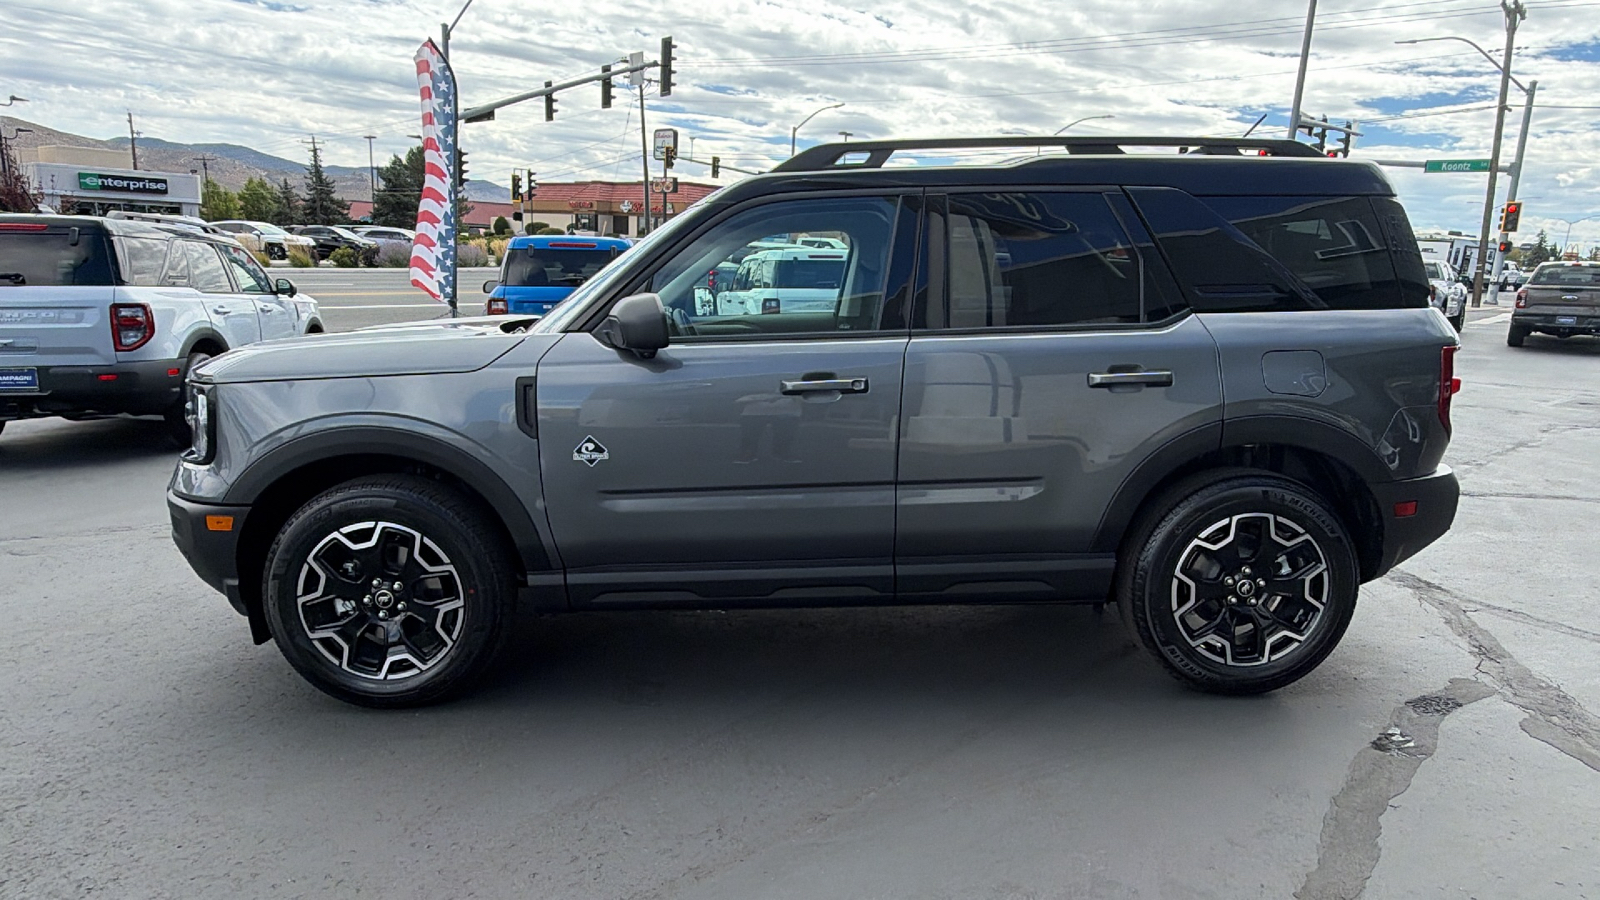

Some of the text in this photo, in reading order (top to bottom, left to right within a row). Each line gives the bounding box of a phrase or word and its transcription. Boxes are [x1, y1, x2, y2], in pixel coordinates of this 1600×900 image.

[1441, 162, 1471, 171] Koontz
[83, 175, 167, 191] enterprise
[1288, 497, 1336, 534] MICHELIN
